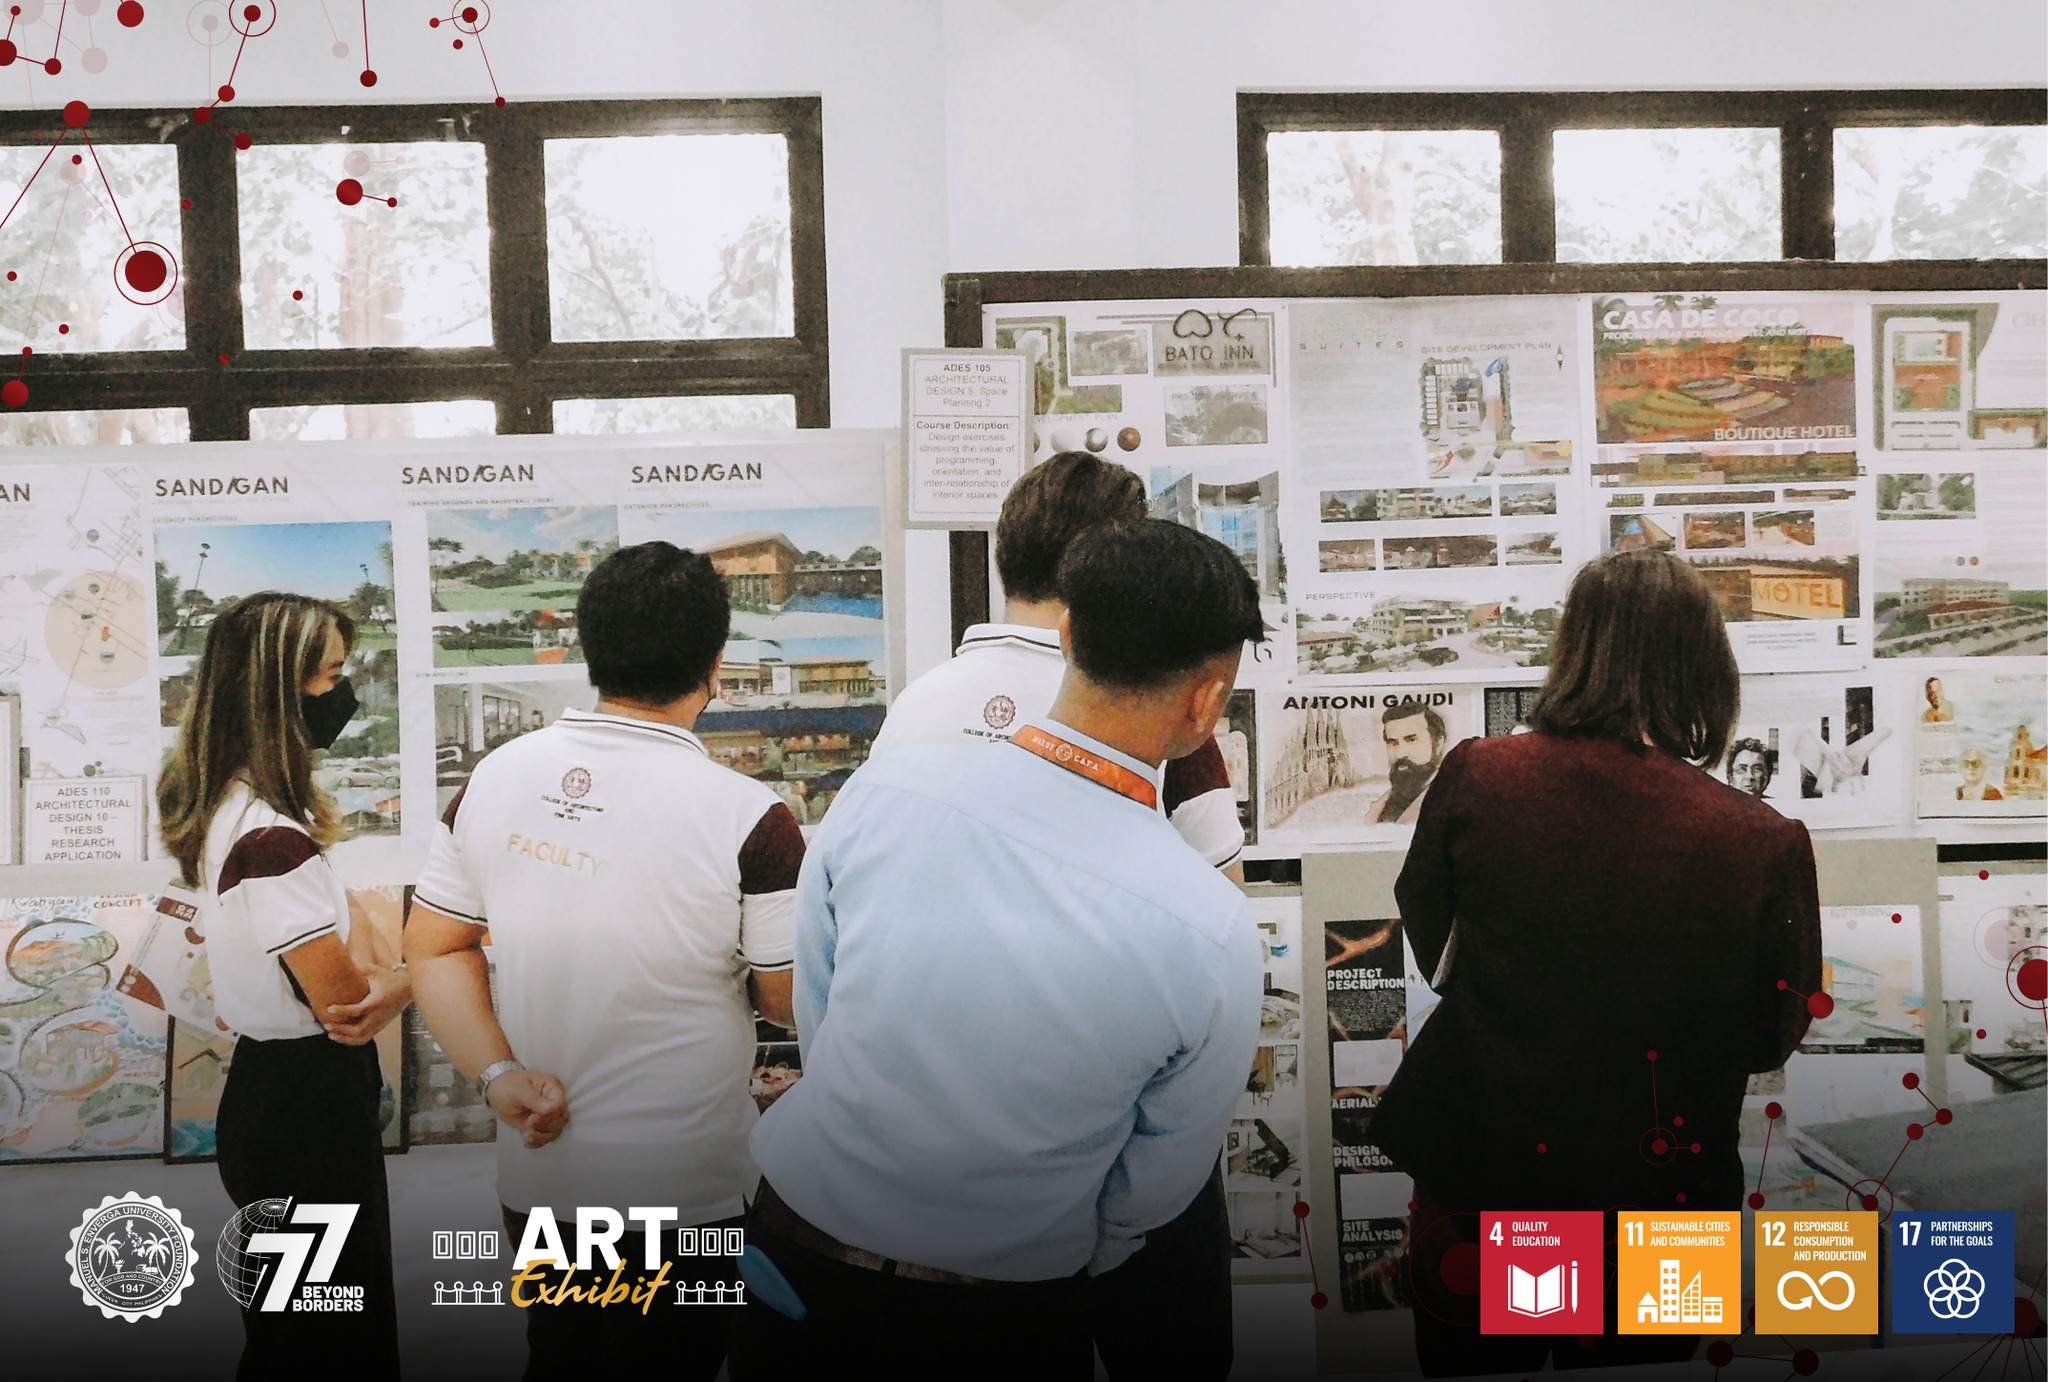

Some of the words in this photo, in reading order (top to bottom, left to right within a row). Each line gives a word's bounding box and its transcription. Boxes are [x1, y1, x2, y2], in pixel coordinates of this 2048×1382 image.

[1603, 309, 1674, 330] CASA
[1681, 308, 1716, 329] DE
[1722, 307, 1799, 327] COCO
[1165, 345, 1212, 361] BATO
[1224, 344, 1254, 360] INN
[1421, 345, 1443, 354] SITE
[1446, 342, 1521, 353] DEVELOPMENT
[1525, 341, 1552, 349] PLAN
[943, 363, 971, 372] ADES
[975, 363, 991, 372] 105
[924, 375, 1008, 384] ARCHITECTURAL
[926, 386, 964, 395] DESIGN
[979, 386, 1008, 396] Space
[943, 399, 982, 408] Planning
[985, 399, 991, 407] 2
[1037, 414, 1088, 423] VELOPMENT
[916, 421, 951, 430] Course
[928, 432, 960, 442] Design
[1714, 426, 1797, 440] BOUTIQUE
[1801, 424, 1855, 438] HOTEL
[919, 445, 960, 454] stressing
[962, 444, 976, 453] the
[978, 444, 1003, 453] value
[1005, 444, 1015, 453] of
[984, 468, 1002, 476] and
[923, 479, 999, 488] inter-relationship
[1001, 479, 1010, 487] of
[932, 491, 963, 499] interior
[1305, 591, 1376, 600] PERSPECTIVE
[1753, 581, 1841, 609] MOTEL
[1283, 694, 1375, 710] ANTONI
[1383, 692, 1454, 709] GAUDI
[963, 728, 985, 738] COLLEGE
[57, 787, 88, 797] ADES
[93, 786, 111, 796] 110
[35, 799, 132, 810] ARCHITECTURAL
[49, 813, 93, 823] DESIGN
[96, 812, 109, 822] 10
[63, 825, 104, 835] THESIS
[51, 838, 115, 848] RESEARCH
[44, 850, 122, 861] APPLICATION
[506, 833, 605, 876] FACULTY
[93, 898, 143, 909] CONCEPT
[1327, 968, 1383, 980] PROJECT
[1327, 978, 1405, 991] DESCRIPTION
[1332, 1098, 1376, 1110] AERIAL
[1333, 1145, 1380, 1157] DESIGN
[1343, 1220, 1370, 1232] SITE
[1342, 1229, 1404, 1243] ANALYSIS
